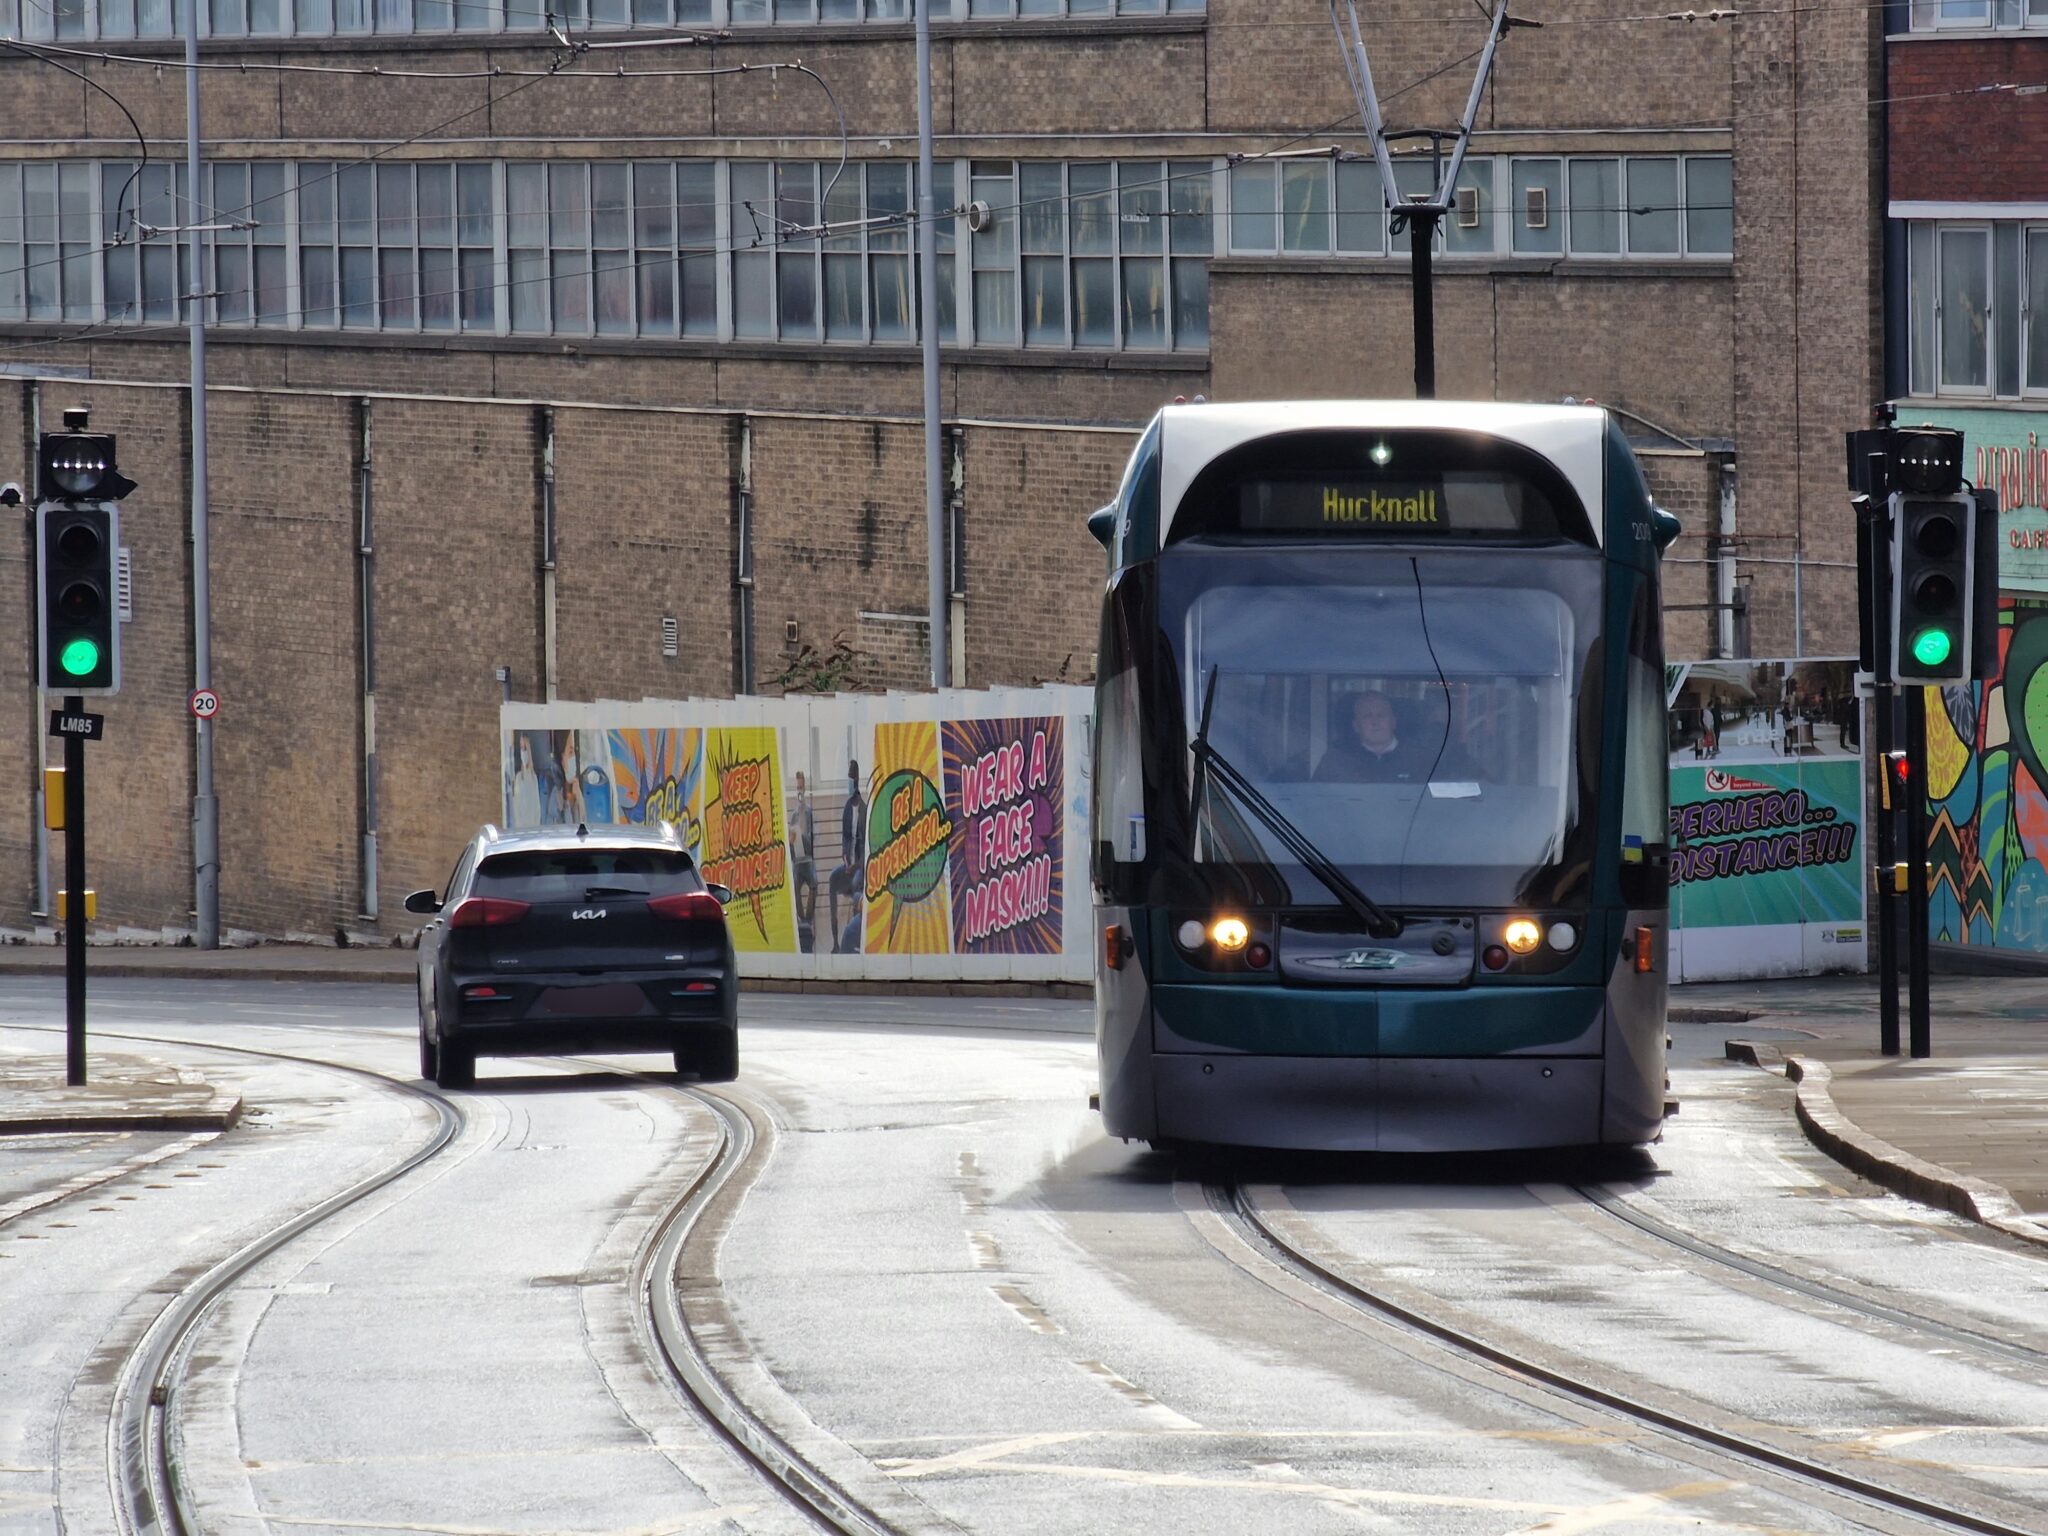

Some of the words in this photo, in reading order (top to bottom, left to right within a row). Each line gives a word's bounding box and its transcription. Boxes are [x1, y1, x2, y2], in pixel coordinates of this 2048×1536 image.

[1323, 486, 1438, 522] Hucknall
[60, 716, 93, 734] LM85
[196, 697, 215, 710] 20
[723, 761, 760, 806] KEEP
[961, 740, 1024, 818] WEAR
[1029, 731, 1047, 790] A
[722, 806, 762, 850] YOUR
[891, 786, 911, 832] BE
[912, 777, 922, 816] A
[867, 808, 952, 897] SUPERHERO...
[978, 800, 1034, 874] FACE
[1669, 826, 1853, 883] DISTANCE!!!
[966, 854, 1051, 943] MASK!!!
